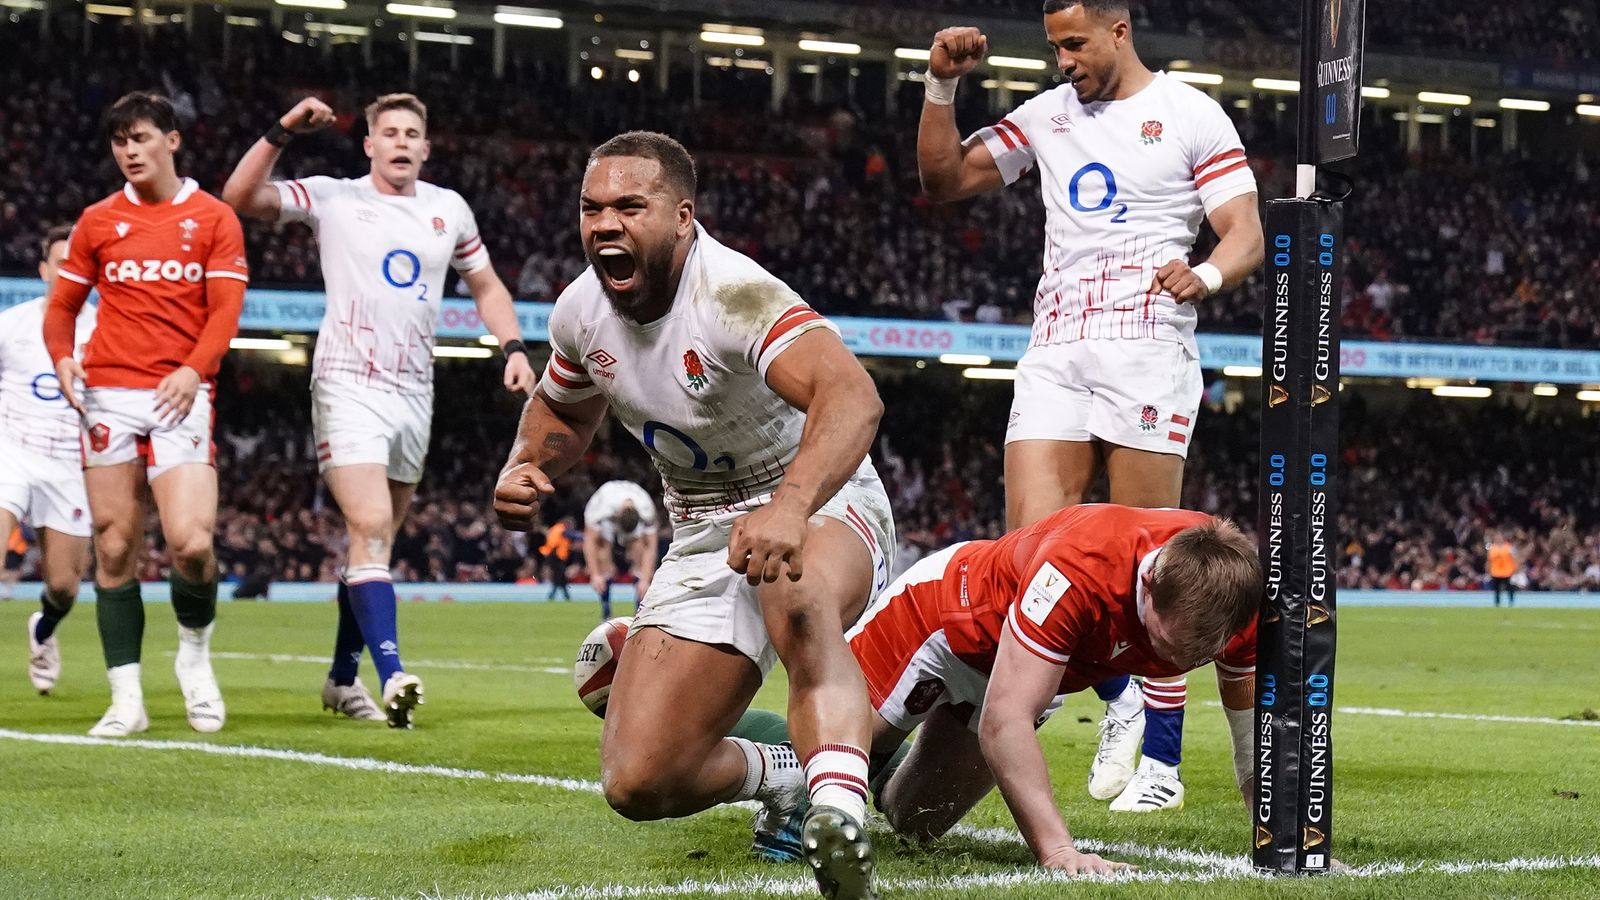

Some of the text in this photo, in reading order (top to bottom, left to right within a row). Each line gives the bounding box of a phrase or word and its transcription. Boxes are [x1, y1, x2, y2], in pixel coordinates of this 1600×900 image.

[1052, 126, 1070, 134] umbro
[105, 259, 204, 283] CAZOO
[1273, 234, 1291, 382] GUINNESS 0.0
[1315, 233, 1334, 381] GUINNESS 0.0
[592, 367, 615, 380] umbro
[869, 327, 954, 349] CAZOO
[1266, 454, 1285, 601] GUINNESS 0.0
[1310, 453, 1327, 602] GUINNESS 0.0
[1259, 712, 1273, 823] GUINNESS
[1308, 674, 1329, 823] GUINNESS 0.0
[1311, 855, 1318, 866] 1
